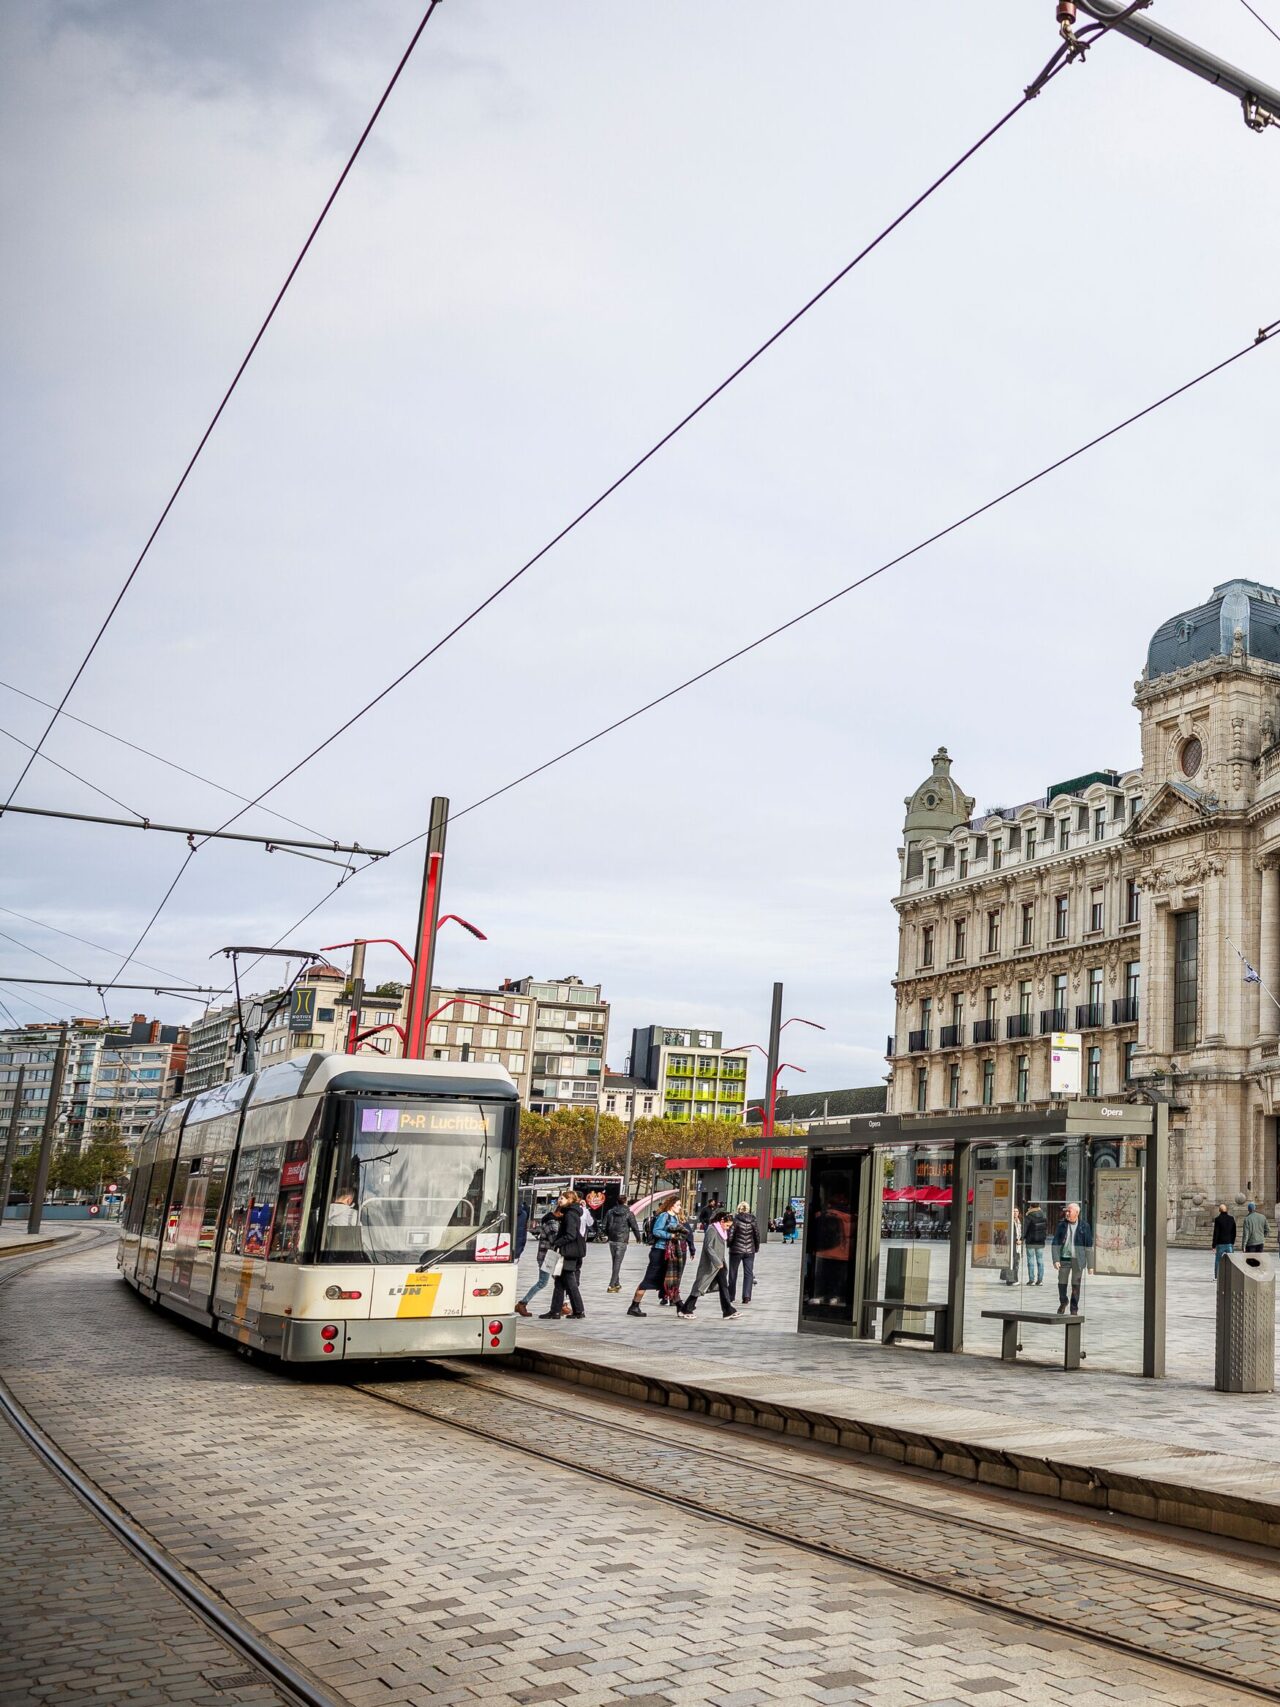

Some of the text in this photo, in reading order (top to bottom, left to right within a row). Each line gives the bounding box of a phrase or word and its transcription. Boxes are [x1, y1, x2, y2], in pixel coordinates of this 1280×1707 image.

[1101, 1107, 1123, 1117] Opera
[374, 1109, 490, 1131] 1 P+R Luchtbal
[868, 1120, 881, 1128] Opera
[443, 1308, 461, 1316] 7264
